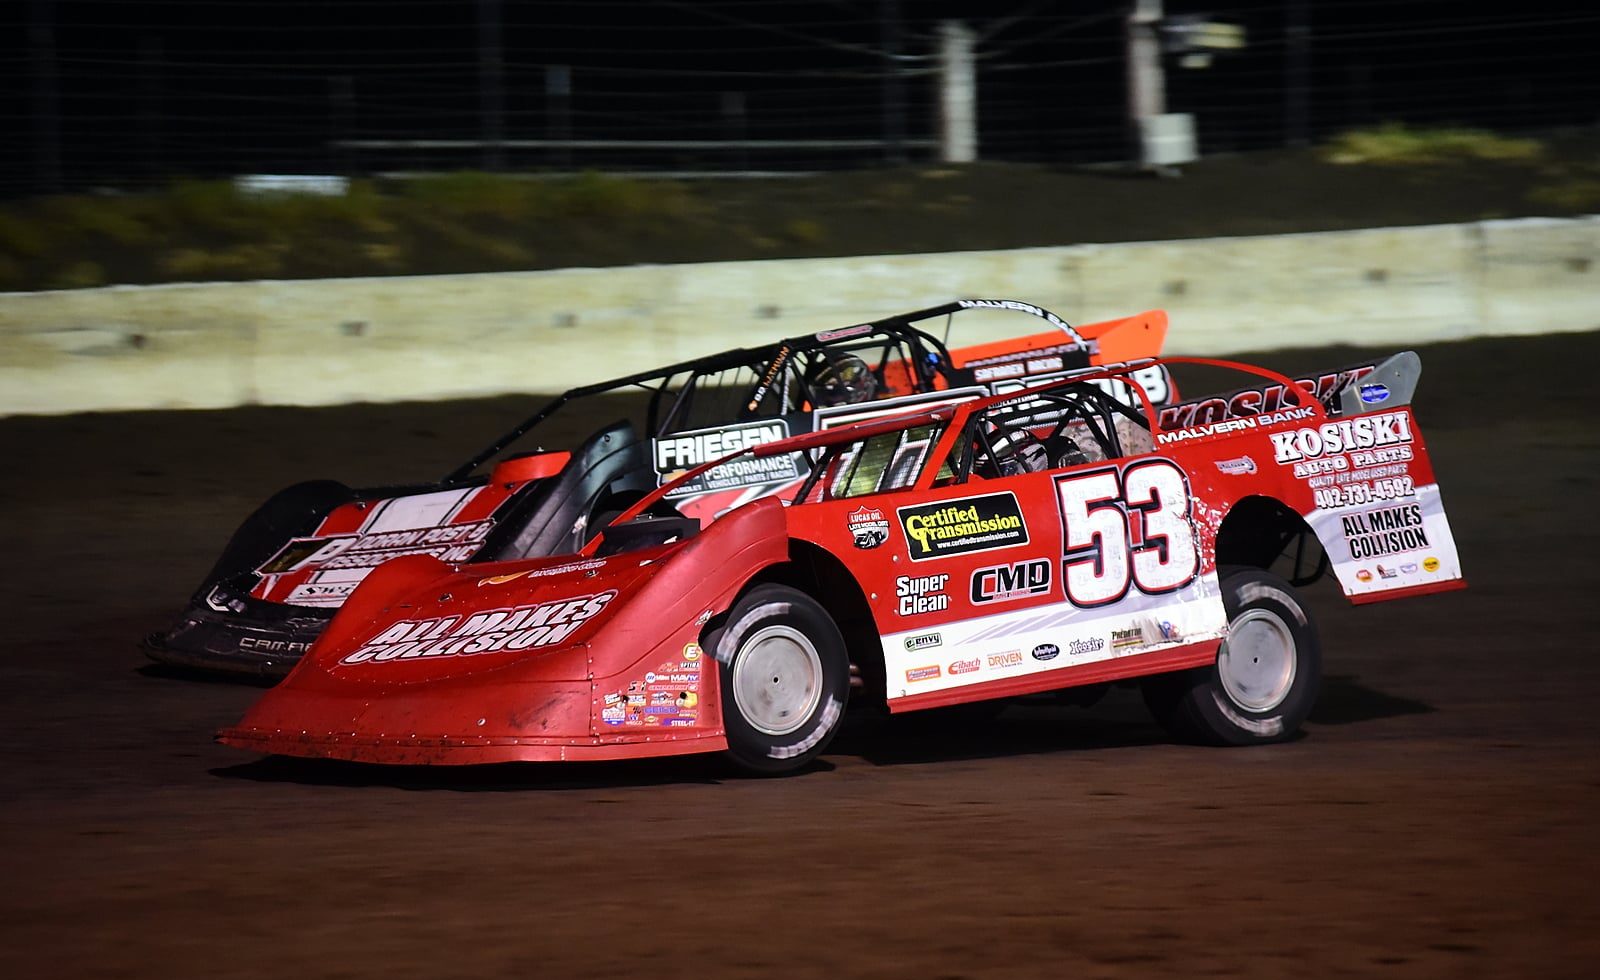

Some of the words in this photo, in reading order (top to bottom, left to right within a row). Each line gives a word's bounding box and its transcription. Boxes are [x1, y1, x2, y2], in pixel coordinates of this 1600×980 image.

[958, 300, 1043, 317] MALVERN
[1159, 366, 1375, 431] KOSISK
[1157, 417, 1257, 444] MALVERN
[1258, 406, 1316, 426] BANK
[1271, 412, 1412, 464] KOSISKI
[658, 425, 783, 468] FRIESEN
[1294, 456, 1347, 478] AUTO
[1352, 447, 1412, 467] PARTS
[704, 454, 792, 480] PERFORMANCE
[1314, 477, 1414, 509] 402-731-4592
[851, 514, 870, 523] LUCAS
[870, 512, 881, 520] OIL
[906, 505, 979, 542] Certified
[915, 514, 1020, 552] Transmission
[1051, 456, 1200, 610] 53
[1342, 514, 1368, 537] ALL
[1368, 505, 1422, 533] MAKES
[418, 525, 475, 544] POST
[936, 531, 1020, 549] www.certifiedtransmission.com
[1349, 527, 1429, 559] COLLISION
[896, 573, 949, 597] Super
[972, 560, 1050, 603] CMD
[367, 618, 456, 645] ALL
[450, 593, 614, 639] MAKES
[899, 593, 948, 616] Clean
[240, 637, 314, 652] CAMAR
[344, 620, 584, 663] COLLISION
[915, 633, 940, 647] envy
[948, 657, 981, 675] Eibach
[988, 652, 1023, 667] DRIVEN
